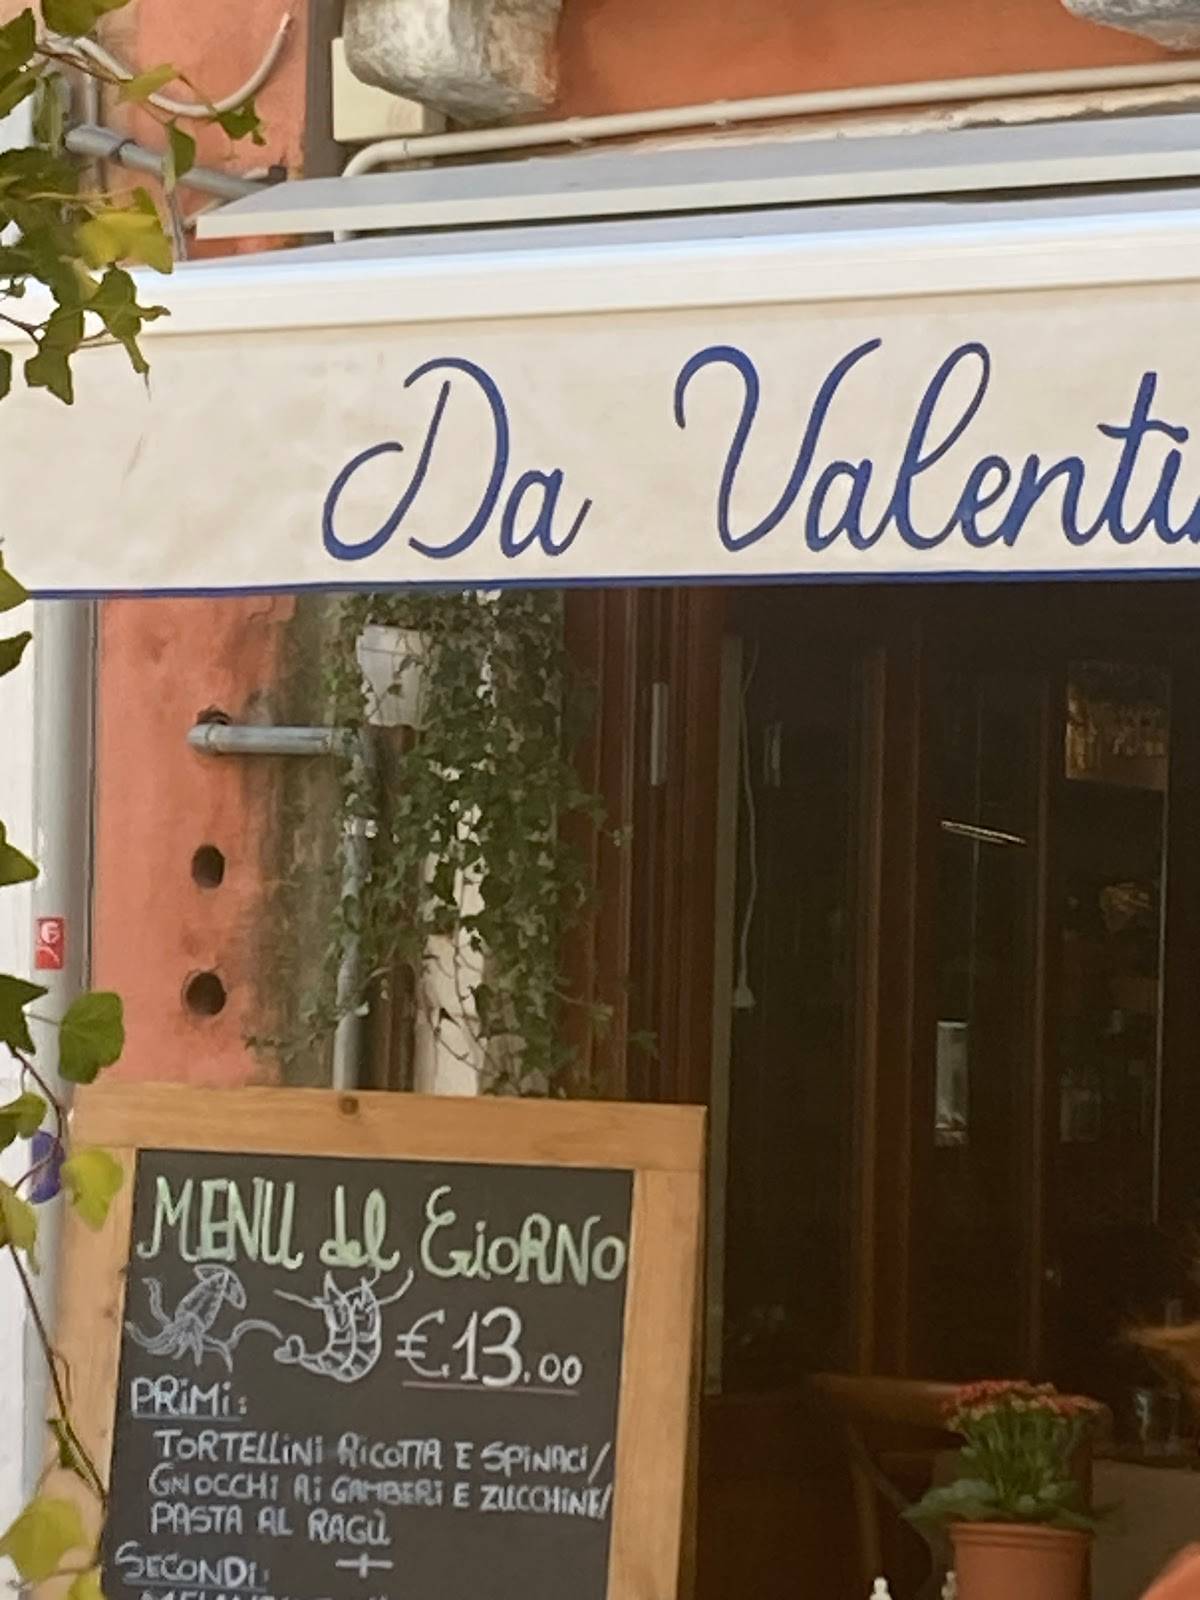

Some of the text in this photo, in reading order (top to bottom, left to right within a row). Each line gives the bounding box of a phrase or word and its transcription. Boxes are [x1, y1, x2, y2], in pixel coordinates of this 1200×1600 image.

[322, 357, 591, 560] Da
[136, 1175, 304, 1270] MENU
[319, 1184, 400, 1272] del
[454, 1441, 474, 1470] E
[453, 1482, 470, 1508] E
[150, 1501, 243, 1536] PASTA
[257, 1506, 294, 1536] AL
